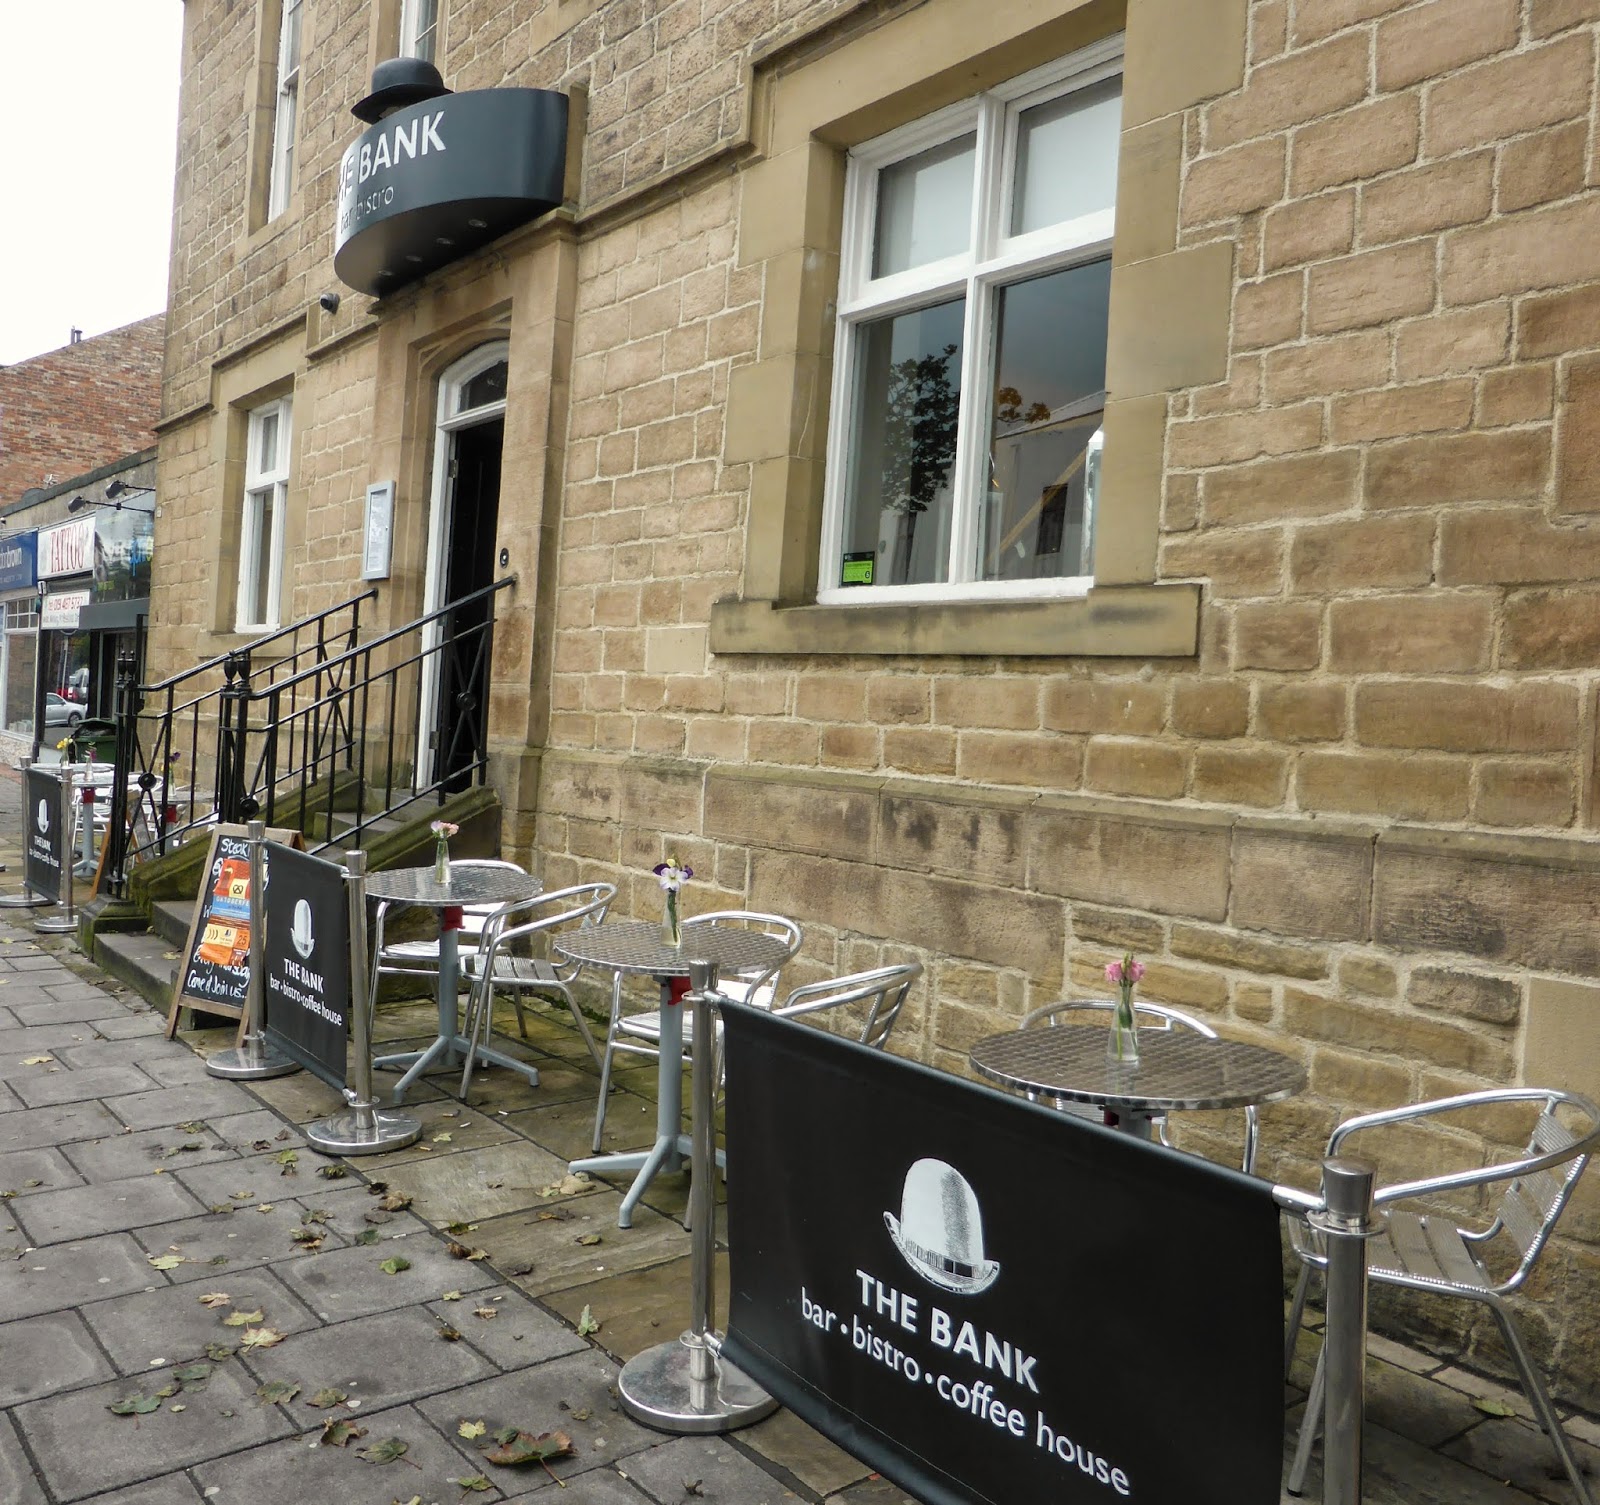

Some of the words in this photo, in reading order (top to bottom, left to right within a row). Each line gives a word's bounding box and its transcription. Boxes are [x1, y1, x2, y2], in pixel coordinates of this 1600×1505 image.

[359, 111, 446, 184] BANK
[356, 186, 393, 220] bistro
[51, 523, 84, 573] TATTOO
[237, 934, 248, 946] 25
[270, 972, 281, 991] bar
[283, 979, 301, 1002] bistro
[302, 994, 321, 1015] coffee
[321, 1000, 342, 1026] house
[283, 957, 300, 980] THE
[301, 966, 323, 994] BANK
[855, 1269, 918, 1333] THE
[930, 1307, 1039, 1394] BANK
[801, 1286, 837, 1332] bar
[852, 1314, 920, 1383] bistro
[936, 1373, 1026, 1437] coffee
[1036, 1410, 1131, 1496] house
